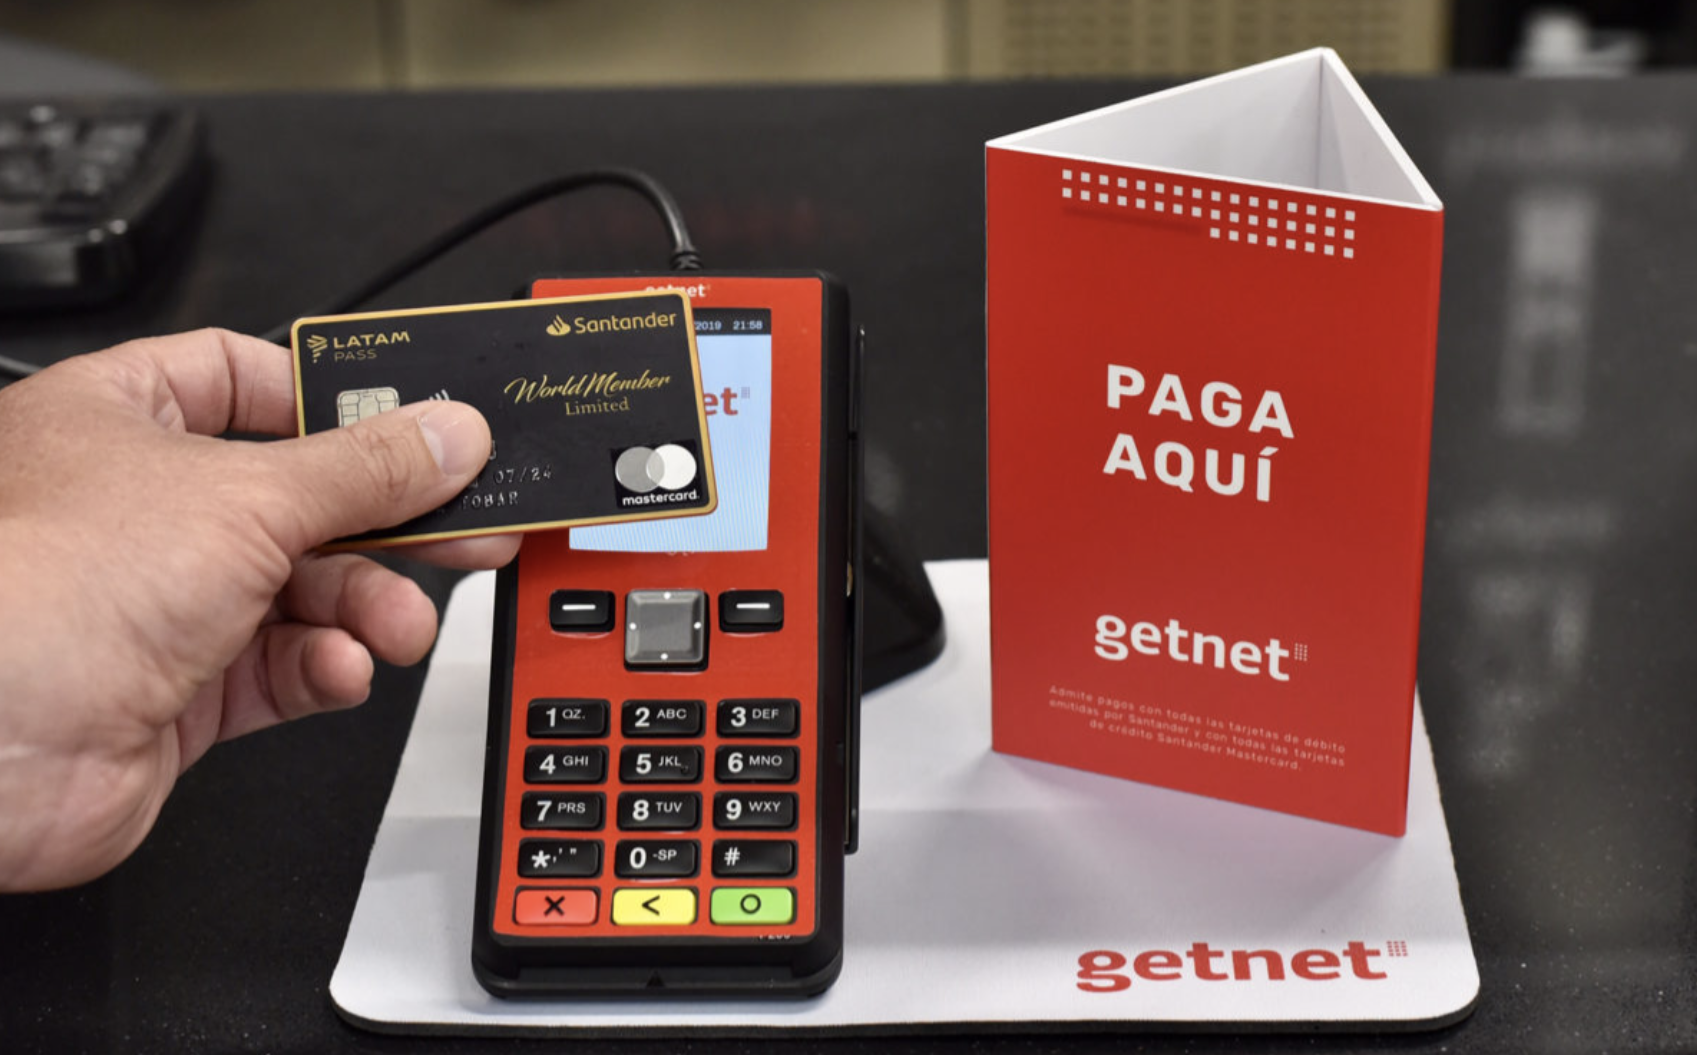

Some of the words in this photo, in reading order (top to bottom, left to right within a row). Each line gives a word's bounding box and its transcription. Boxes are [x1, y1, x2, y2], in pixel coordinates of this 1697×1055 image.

[572, 313, 677, 335] Santander
[694, 320, 722, 331] 2019
[732, 320, 764, 331] 21:58
[333, 330, 411, 349] LATAM
[334, 348, 378, 362] PASS
[565, 397, 631, 416] Limited
[1106, 362, 1295, 440] PAGA
[1102, 432, 1280, 503] AQUÍ
[622, 488, 698, 506] mastercard
[1094, 614, 1291, 682] getnet
[546, 707, 557, 728] 1
[634, 706, 650, 728] 2
[656, 708, 687, 719] ABC
[730, 706, 747, 728] 3
[752, 708, 779, 719] DEF
[1049, 685, 1094, 703] Admite
[1097, 695, 1135, 712] pagos
[1139, 704, 1162, 716] con
[1166, 708, 1202, 725] todas
[1206, 716, 1225, 729] las
[1229, 721, 1280, 741] tarjetas
[1284, 733, 1300, 744] de
[1304, 737, 1346, 754] débito
[1049, 699, 1100, 717] emitidas
[1104, 710, 1124, 722] por
[1128, 713, 1190, 735] Santander
[1194, 729, 1201, 739] y
[1205, 731, 1228, 743] con
[1232, 735, 1267, 751] todas
[1271, 744, 1289, 756] las
[1293, 748, 1346, 768] tarjetas
[1089, 719, 1105, 730] de
[1107, 724, 1154, 741] crédito
[1157, 732, 1222, 755] Santander
[539, 753, 556, 775] 4
[562, 755, 589, 766] GHI
[635, 753, 652, 775] 5
[658, 756, 682, 767] JKL
[727, 752, 744, 774] 6
[749, 755, 783, 766] MNO
[537, 800, 552, 822] 7
[557, 802, 586, 814] PRS
[632, 799, 650, 821] 8
[656, 801, 683, 813] TUV
[726, 798, 742, 821] 9
[748, 801, 781, 812] WXY
[629, 846, 647, 870] 0
[724, 847, 741, 866] #
[1076, 940, 1388, 993] getnet
